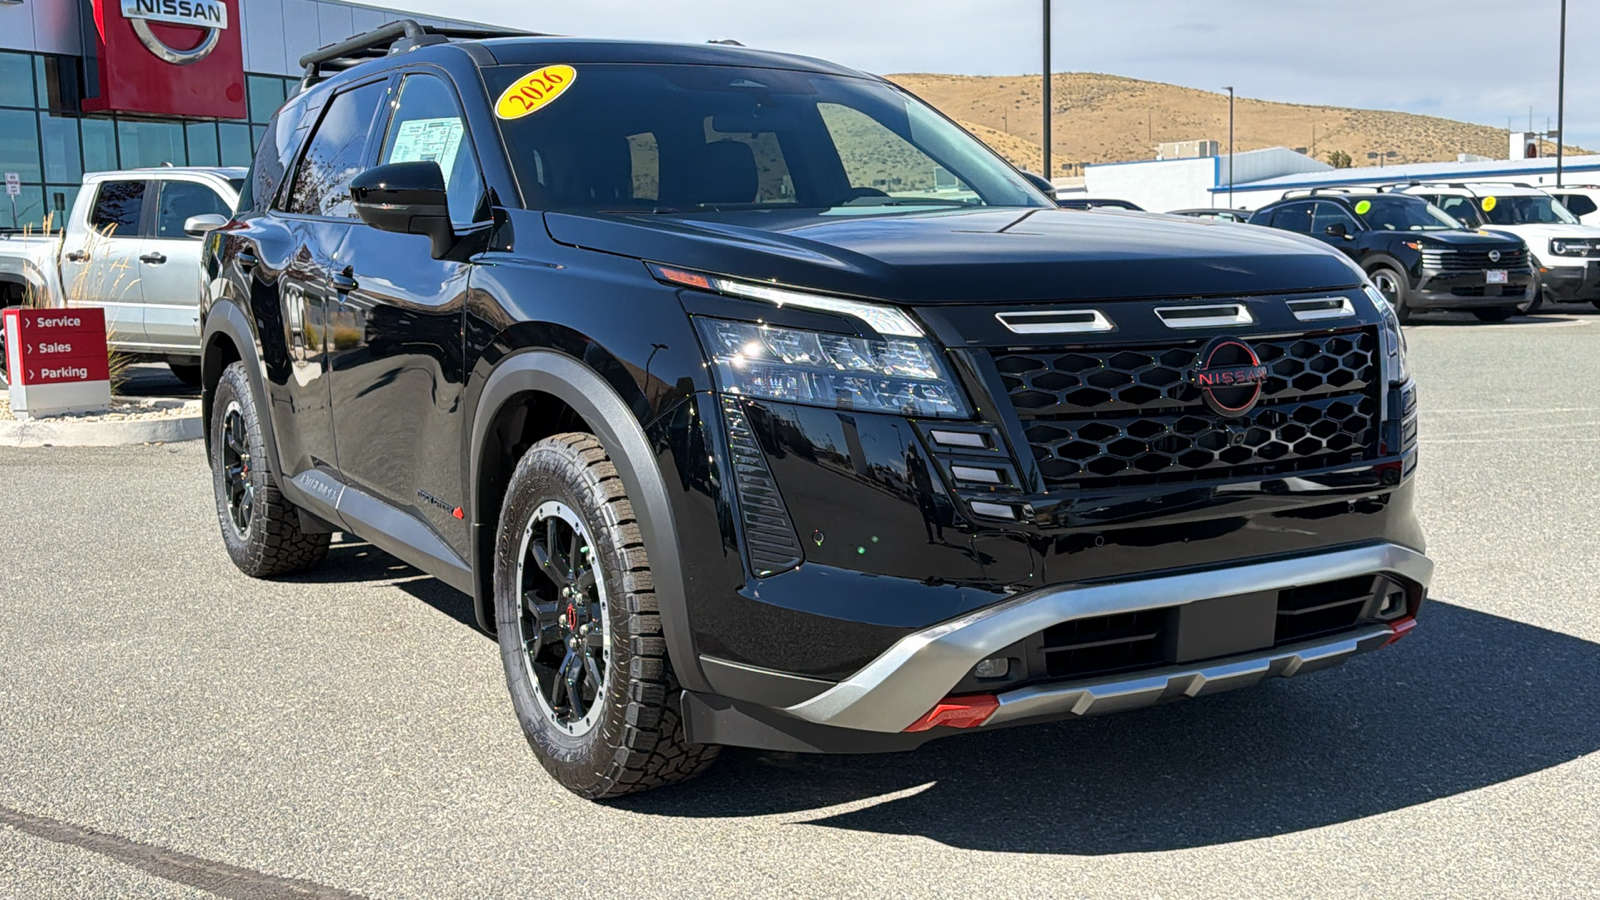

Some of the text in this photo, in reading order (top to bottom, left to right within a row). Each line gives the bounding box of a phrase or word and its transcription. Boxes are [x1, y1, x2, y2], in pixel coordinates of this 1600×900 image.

[136, 0, 221, 22] NISSAN
[508, 70, 564, 111] 2026
[36, 316, 81, 328] Service
[38, 342, 72, 354] Sales
[41, 366, 88, 379] Parking
[1199, 367, 1267, 385] NISSAN
